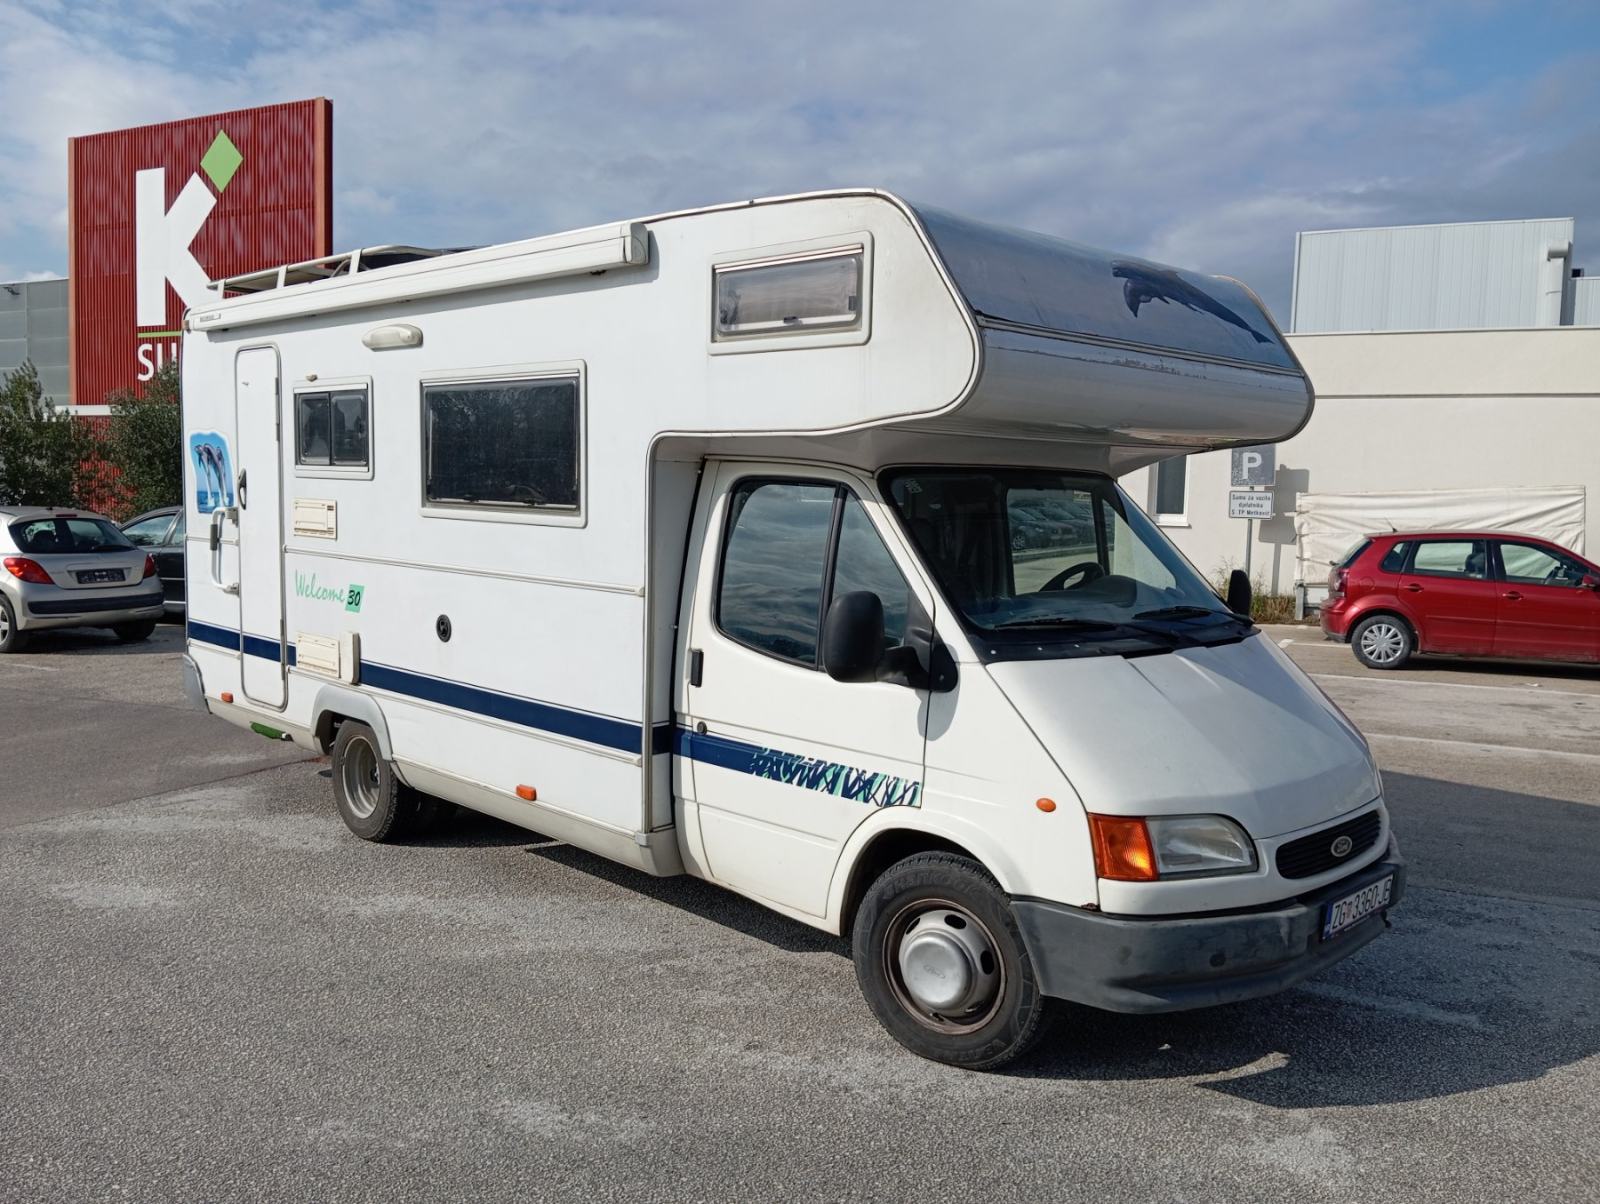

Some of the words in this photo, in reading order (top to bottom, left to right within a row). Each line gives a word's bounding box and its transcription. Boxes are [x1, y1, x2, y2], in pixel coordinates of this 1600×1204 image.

[136, 167, 221, 326] K
[1242, 452, 1262, 480] P
[295, 569, 345, 603] Welcome
[347, 589, 361, 606] 30
[1332, 901, 1347, 929] ZG
